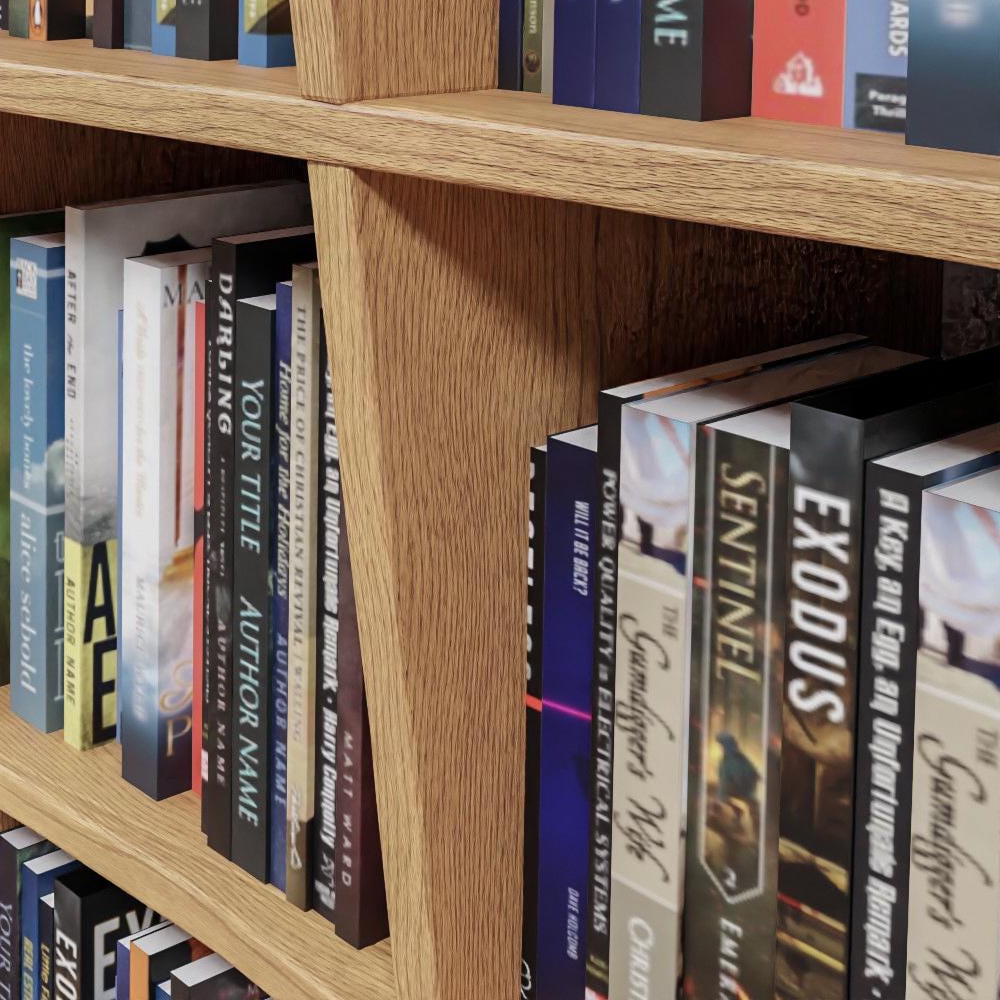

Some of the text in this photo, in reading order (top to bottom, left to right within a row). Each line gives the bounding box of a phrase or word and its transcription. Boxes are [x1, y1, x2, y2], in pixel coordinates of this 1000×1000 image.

[23, 343, 35, 375] the
[66, 269, 78, 325] AFTER
[215, 272, 235, 436] DARLING
[296, 307, 307, 343] THE
[66, 362, 78, 400] END
[295, 418, 307, 446] OF
[239, 378, 265, 554] YOUR TITLE
[275, 359, 291, 597] Home for the Holidays
[293, 453, 306, 557] CHRISTIAN
[879, 487, 910, 514] A
[20, 512, 38, 694] alice sebold
[321, 497, 341, 693] Unfortunate Remark
[573, 500, 590, 598] WILL IT BE BACK?
[713, 461, 767, 683] SENTINEL
[787, 484, 851, 724] EXODUS
[873, 576, 904, 616] an
[64, 576, 77, 707] AUTHOR NAME
[216, 618, 228, 788] AUTHOR NAME
[237, 595, 263, 828] AUTHOR NAME
[592, 468, 618, 936] POWER QUALITY ELECTRICAL SYSTEMS
[868, 676, 901, 717] an
[274, 632, 288, 807] AUTHOR NAME
[320, 706, 338, 849] Harry Connolly
[341, 730, 355, 887] MATT WARD
[865, 716, 903, 879] Unfortunate
[0, 902, 13, 972] YOUR
[863, 874, 898, 986] Remark
